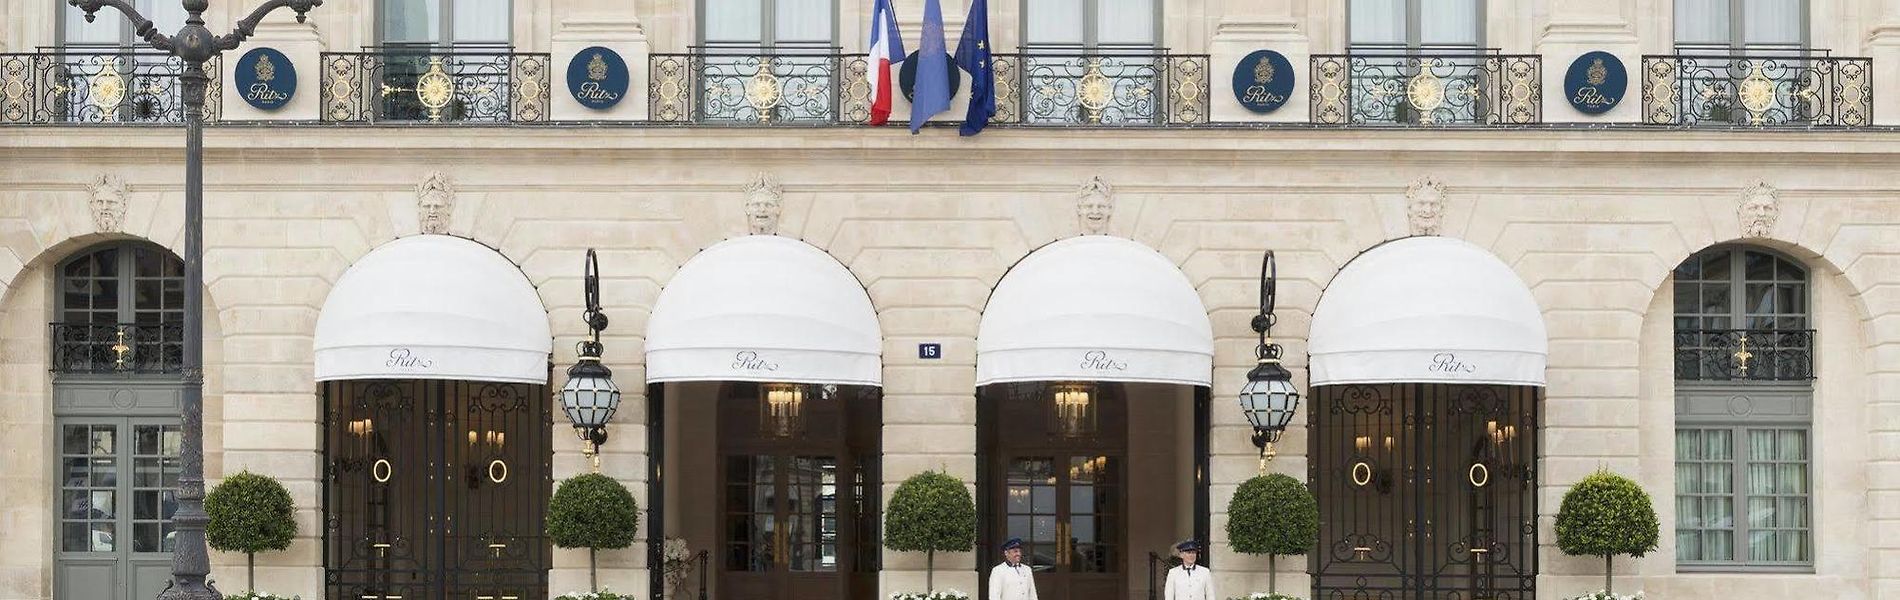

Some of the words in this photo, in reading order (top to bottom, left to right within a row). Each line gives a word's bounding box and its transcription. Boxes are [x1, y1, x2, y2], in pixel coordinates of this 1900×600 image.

[248, 83, 288, 101] Ritz
[577, 82, 618, 100] Ritz
[1242, 85, 1284, 103] Ritz
[1573, 87, 1615, 105] Ritz
[385, 348, 432, 368] Ritz
[924, 346, 936, 356] 15
[1080, 350, 1128, 370] Ritz
[731, 350, 779, 371] Ritz
[1428, 352, 1476, 373] Ritz
